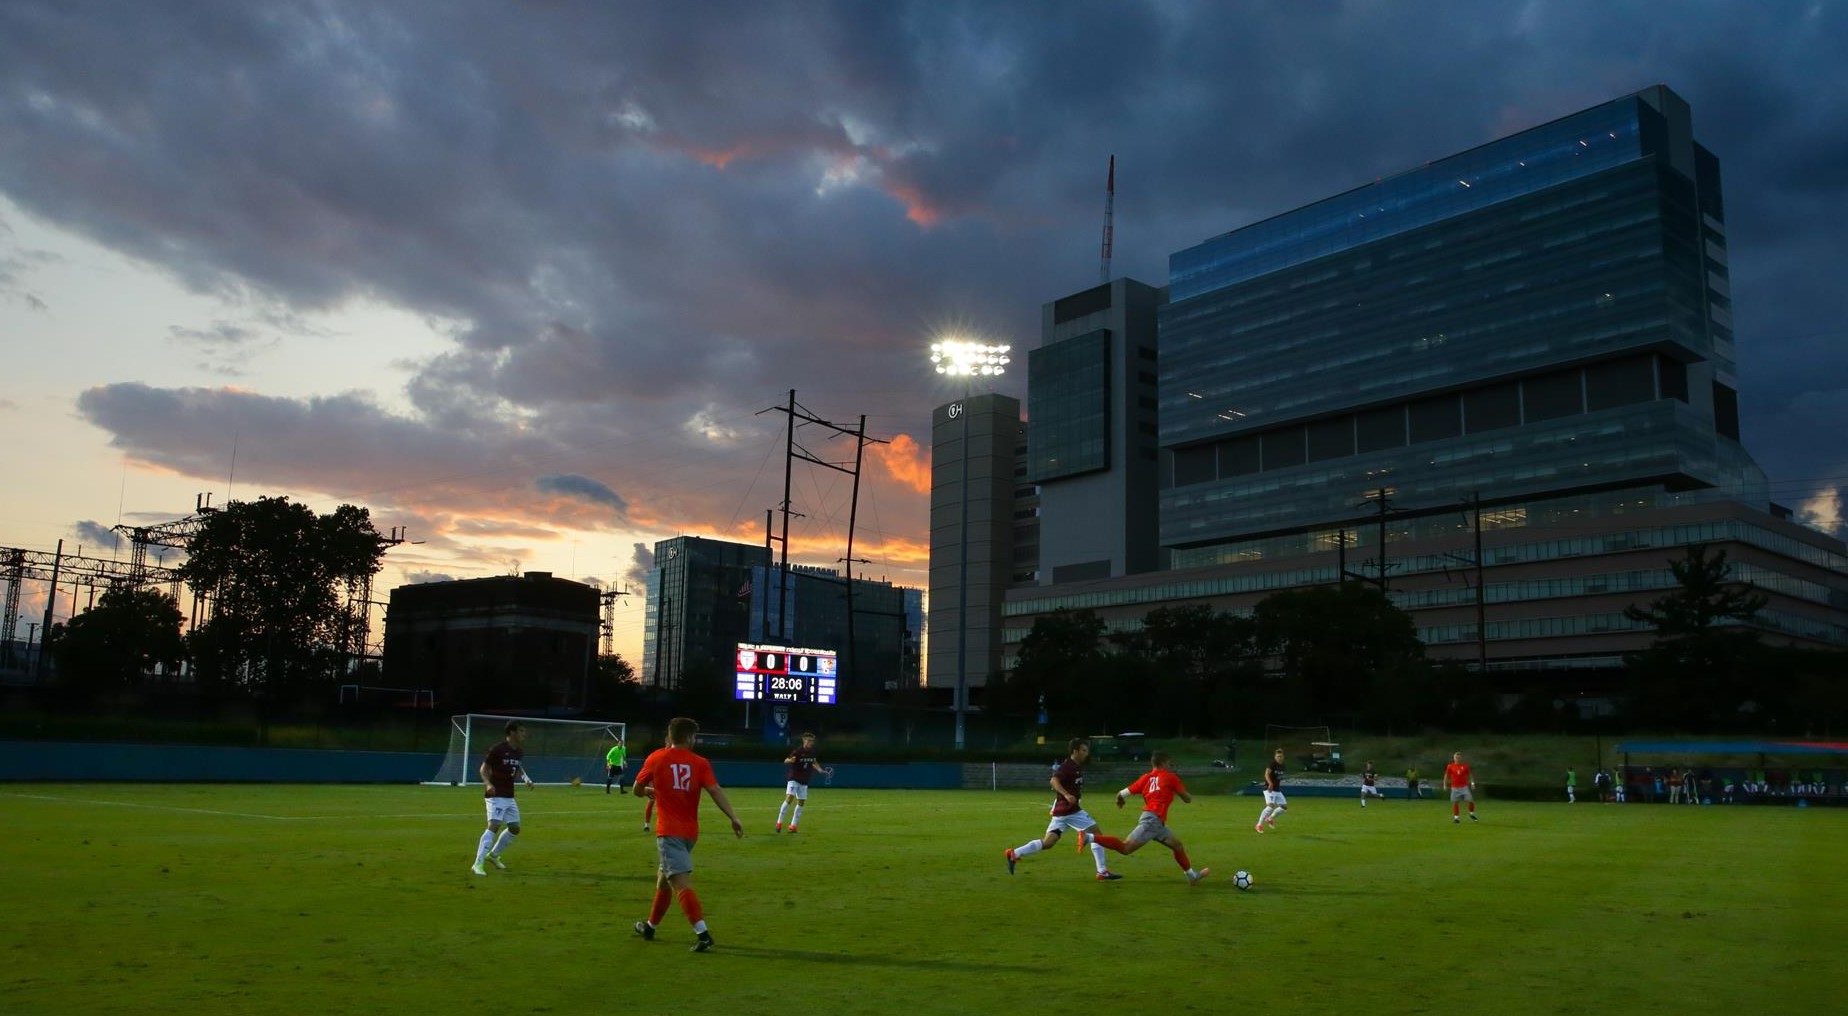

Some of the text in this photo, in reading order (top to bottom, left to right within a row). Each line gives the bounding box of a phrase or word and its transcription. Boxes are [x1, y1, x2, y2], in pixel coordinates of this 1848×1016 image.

[766, 653, 776, 670] 0
[799, 656, 809, 672] 0
[771, 677, 803, 691] 28:06
[670, 763, 691, 790] 12
[1148, 776, 1161, 793] 21
